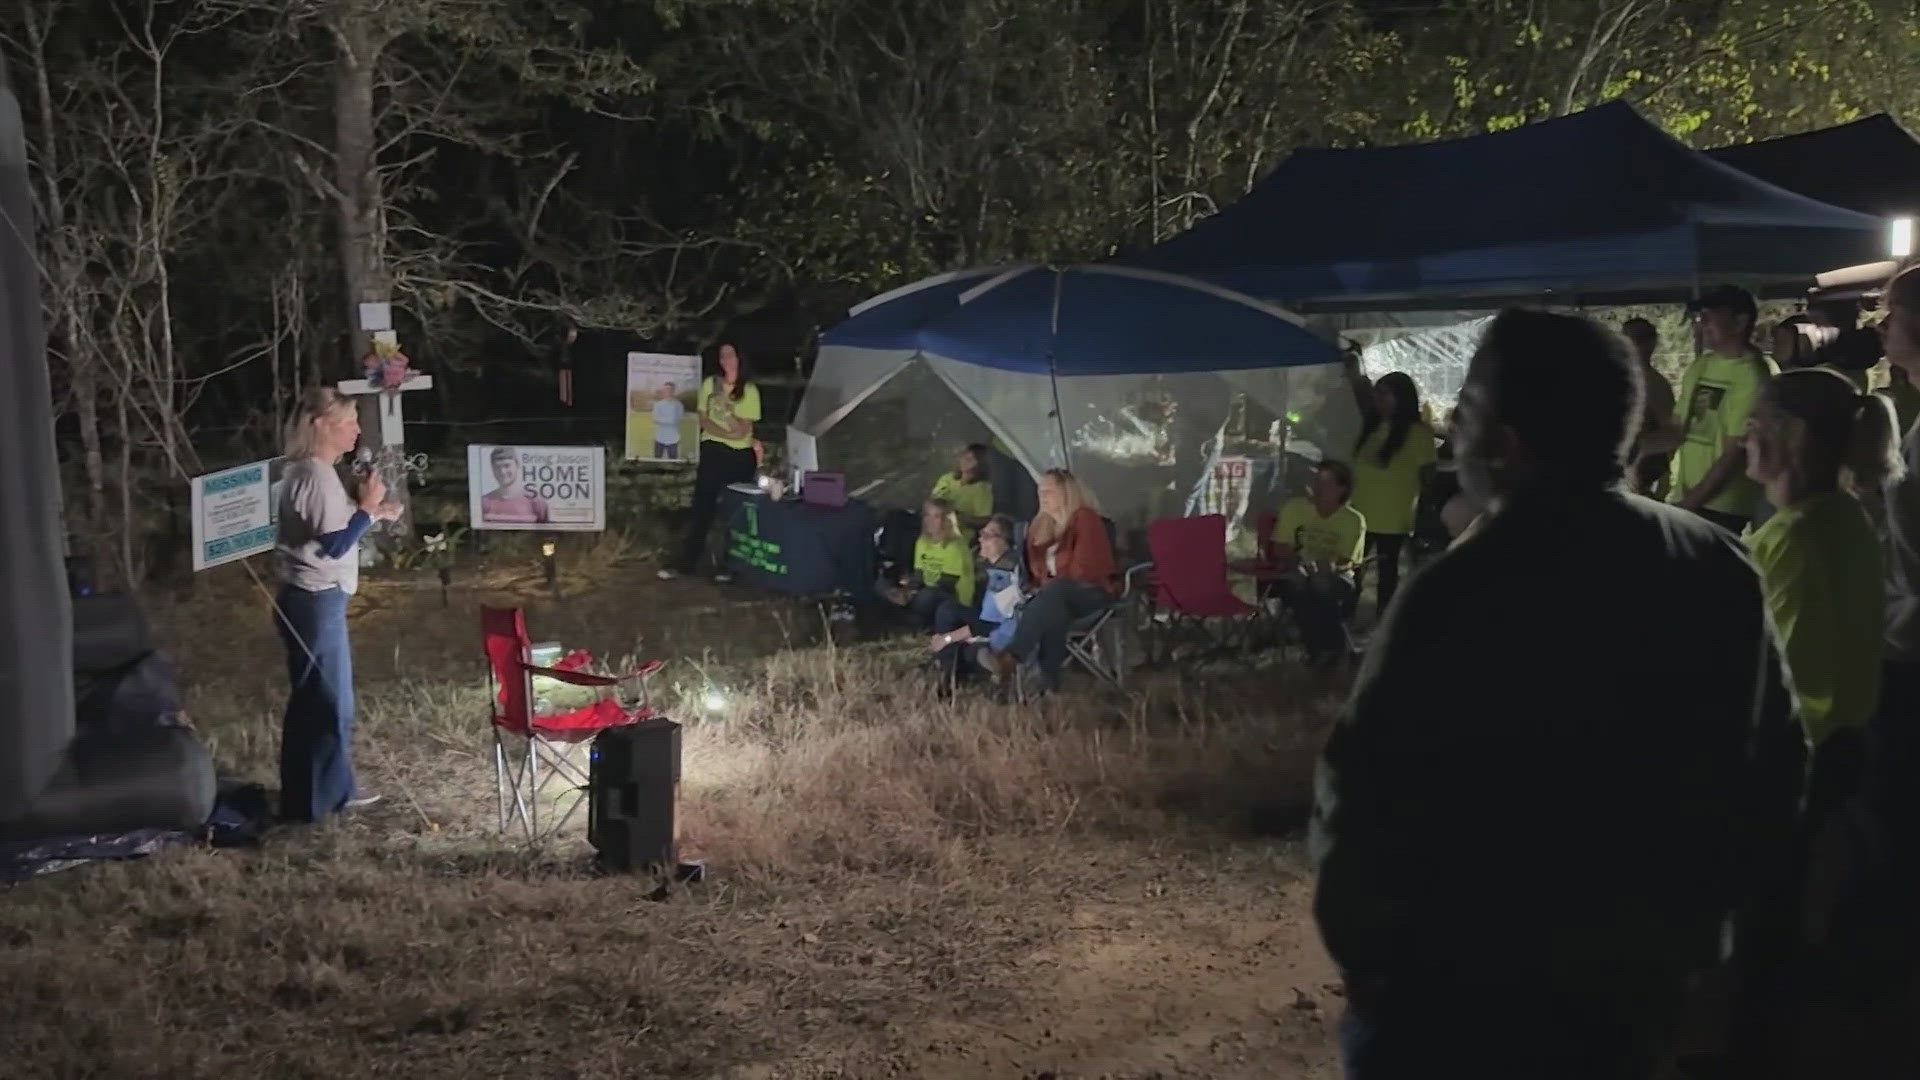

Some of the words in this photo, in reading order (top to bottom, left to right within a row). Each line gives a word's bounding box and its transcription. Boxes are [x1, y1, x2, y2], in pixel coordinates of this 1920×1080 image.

[521, 453, 553, 465] Bring
[557, 454, 590, 464] Jason
[205, 468, 262, 492] MISSING
[522, 465, 590, 482] HOME
[523, 483, 590, 500] SOON
